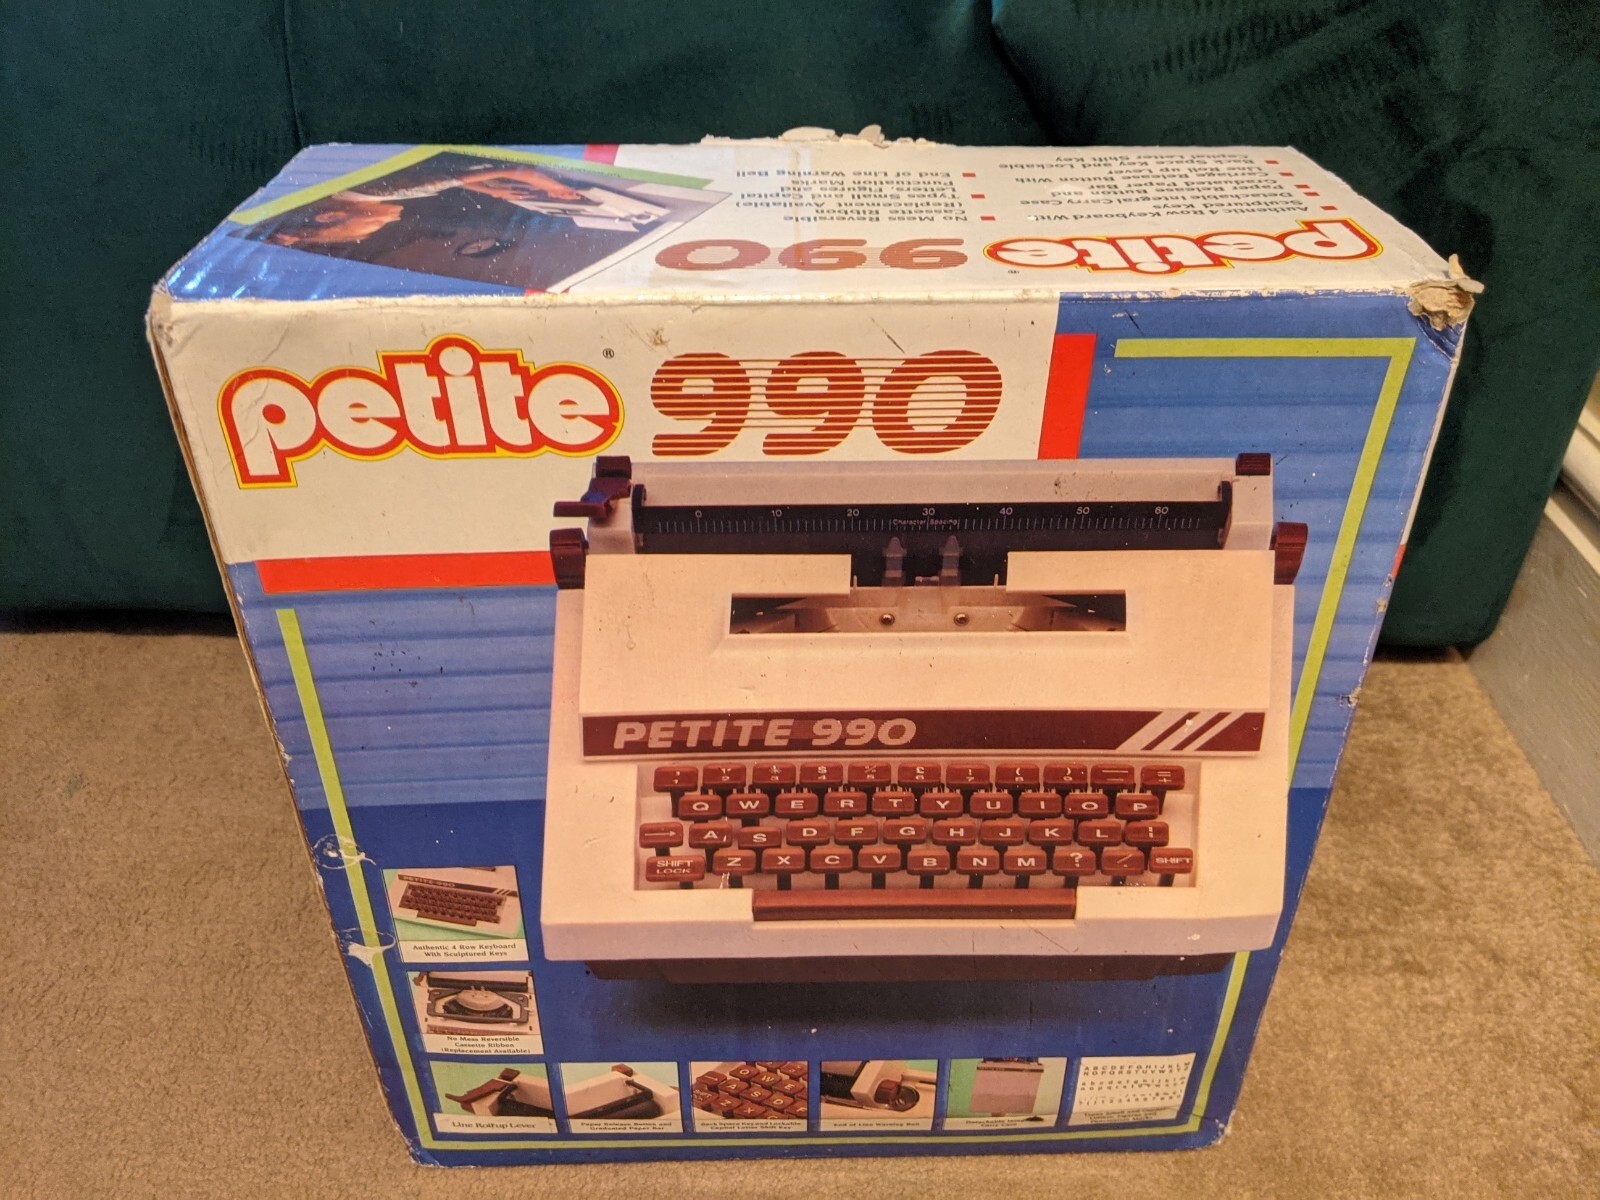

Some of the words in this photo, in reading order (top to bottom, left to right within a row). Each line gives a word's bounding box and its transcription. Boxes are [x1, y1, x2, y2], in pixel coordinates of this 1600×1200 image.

[1195, 171, 1269, 179] Carriage
[1126, 181, 1177, 189] Paper
[1183, 179, 1278, 187] Graduated
[1232, 183, 1283, 191] Paper
[740, 192, 803, 200] Capital
[1117, 194, 1187, 204] Integral
[1189, 191, 1293, 201] Detachable
[1067, 198, 1113, 206] Carry
[1203, 200, 1303, 209] Sculptured
[1223, 206, 1309, 215] Authentic
[1072, 211, 1161, 220] Keyboard
[983, 218, 1382, 276] petite
[655, 238, 968, 271] 990
[650, 350, 1002, 456] 990
[217, 333, 625, 489] petite
[695, 510, 703, 518] 0
[771, 509, 782, 518] 10
[847, 508, 860, 518] 20
[922, 507, 936, 516] 30
[1000, 506, 1013, 515] 40
[1077, 506, 1090, 515] 50
[1155, 506, 1169, 515] 60
[612, 718, 796, 750] PETITE
[809, 717, 918, 747] 990
[692, 801, 710, 812] Q
[738, 800, 760, 810] W
[790, 800, 804, 809] E
[840, 799, 854, 809] R
[888, 798, 903, 808] T
[935, 800, 950, 809] Y
[985, 800, 1001, 810] U
[1040, 801, 1045, 810] I
[1081, 801, 1099, 811] O
[1133, 802, 1148, 811] P
[703, 830, 718, 839] A
[752, 833, 768, 843] S
[802, 827, 818, 837] D
[851, 827, 864, 837] F
[899, 826, 916, 836] G
[949, 828, 964, 837] H
[999, 828, 1011, 837] J
[1044, 827, 1060, 837] K
[1095, 828, 1108, 838] L
[656, 859, 694, 868] SHIFT
[727, 857, 742, 867] Z
[777, 855, 791, 865] X
[824, 855, 840, 865] C
[872, 855, 887, 865] V
[922, 857, 937, 867] B
[972, 857, 987, 867] N
[1017, 857, 1036, 867] M
[1155, 856, 1193, 864] SHIFT
[479, 943, 516, 951] Keyboard
[443, 950, 487, 958] Sculptured
